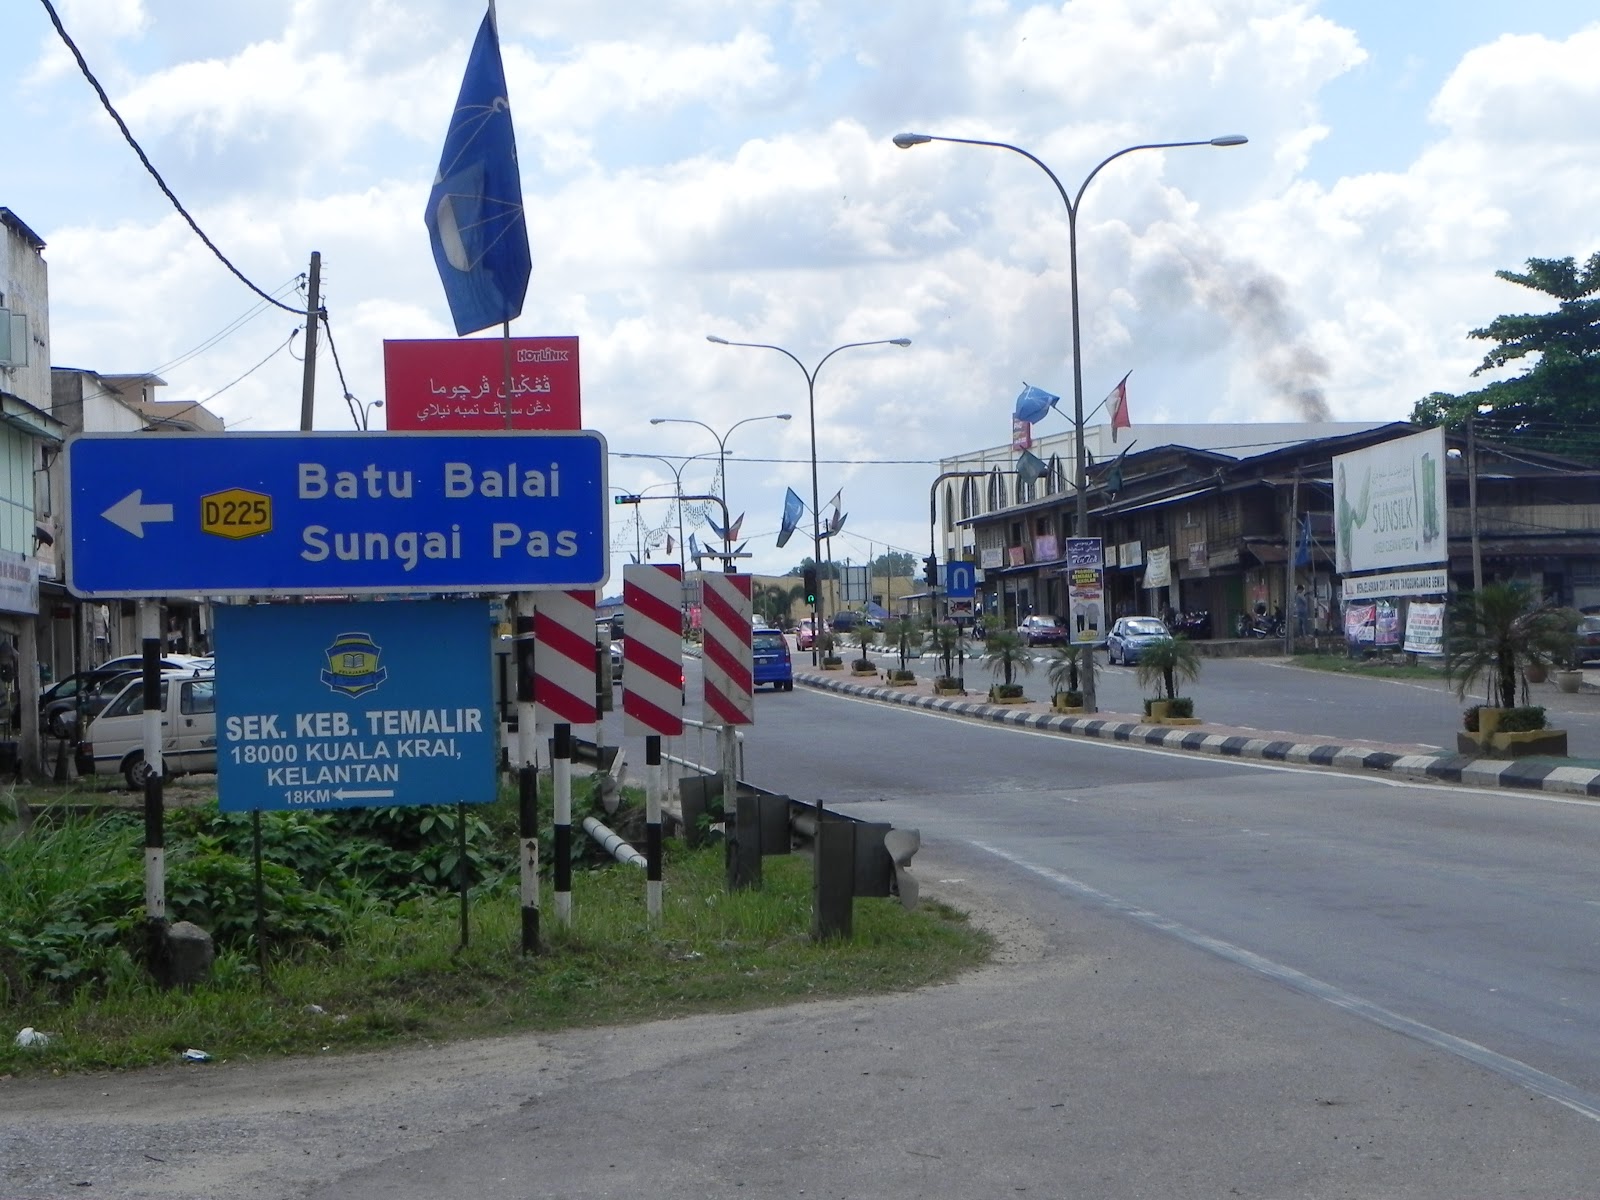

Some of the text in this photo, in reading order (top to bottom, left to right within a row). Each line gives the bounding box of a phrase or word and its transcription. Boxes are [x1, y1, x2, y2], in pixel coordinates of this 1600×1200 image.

[298, 461, 560, 499] Batu Balai
[205, 500, 268, 526] D225
[1373, 497, 1414, 533] SUNSILK
[300, 522, 578, 572] Sungai Pas
[226, 708, 482, 742] SEK. KEB. TEMALIR
[230, 738, 462, 764] 18000 KUALA KRAI,
[267, 763, 399, 787] KELANTAN
[284, 789, 330, 805] 18KM
